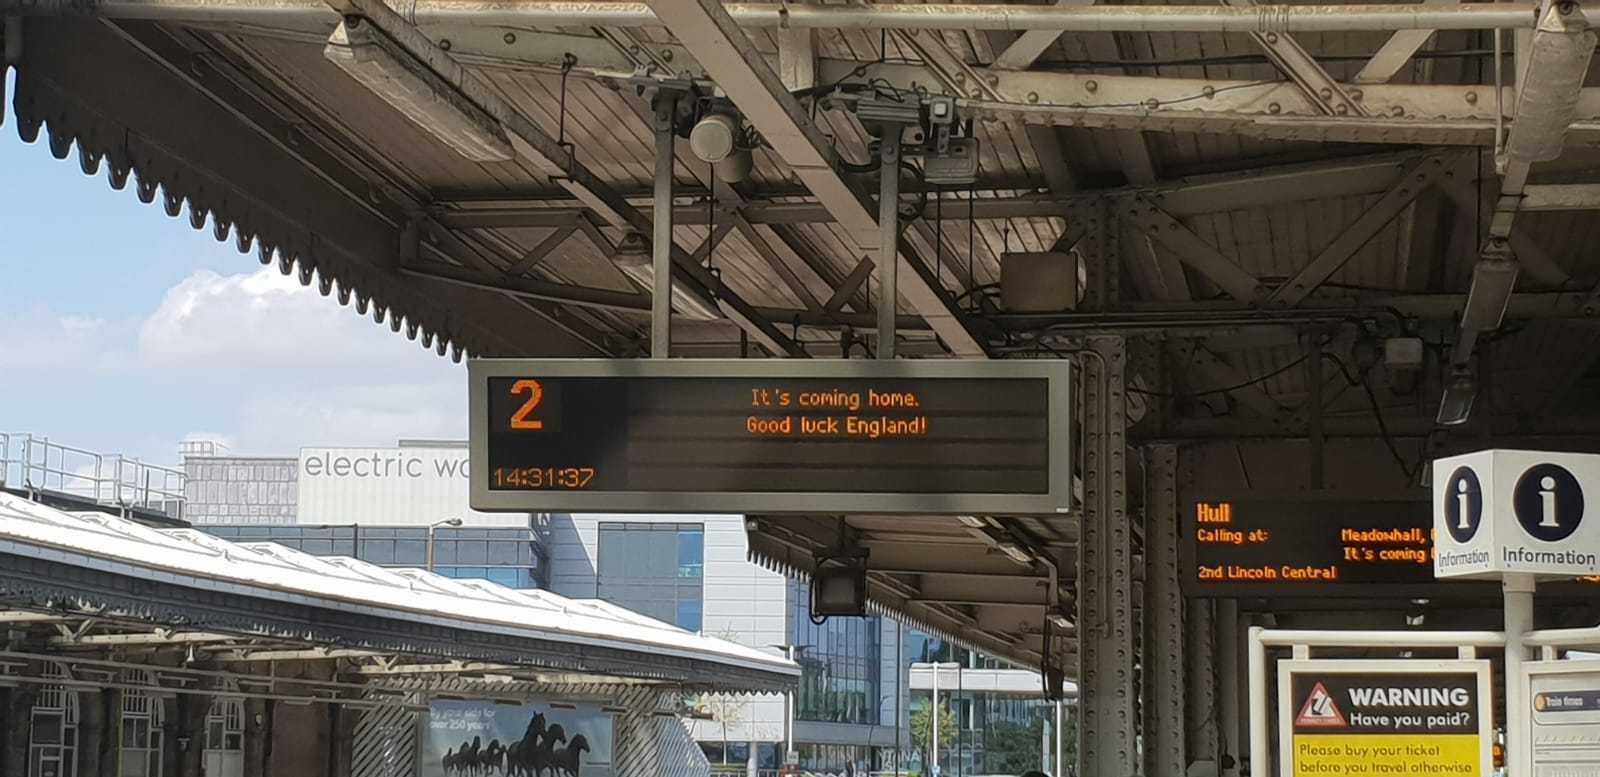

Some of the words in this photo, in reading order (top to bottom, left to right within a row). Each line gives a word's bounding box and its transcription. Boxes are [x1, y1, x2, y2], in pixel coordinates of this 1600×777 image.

[510, 379, 543, 429] 2
[752, 389, 791, 406] It's
[799, 389, 860, 410] coming
[869, 389, 919, 406] home.
[746, 416, 791, 433] Good
[801, 416, 839, 433] luck
[847, 416, 926, 438] England!
[305, 451, 423, 477] electric
[494, 467, 595, 487] 14:31:37
[1197, 503, 1231, 522] Hull
[1197, 528, 1243, 544] Calling
[1248, 529, 1269, 542] at:
[1341, 528, 1426, 544] Meadowhall,
[1343, 546, 1375, 561] It's
[1379, 546, 1426, 563] coming
[1438, 549, 1490, 568] Information
[1503, 546, 1596, 566] Information
[1198, 565, 1223, 579] 2nd
[1227, 565, 1277, 579] Lincoln
[1281, 565, 1337, 579] Central
[1348, 687, 1470, 707] WARNING
[1350, 712, 1390, 727] Have
[1394, 716, 1422, 729] you
[1427, 712, 1471, 730] paid?
[1299, 744, 1341, 757] Please
[1345, 744, 1369, 758] buy
[1372, 746, 1402, 758] your
[1405, 744, 1440, 757] ticket
[1300, 761, 1341, 774] before
[1344, 764, 1368, 776] you
[1372, 761, 1407, 774] travel
[1410, 760, 1473, 774] otherwise
